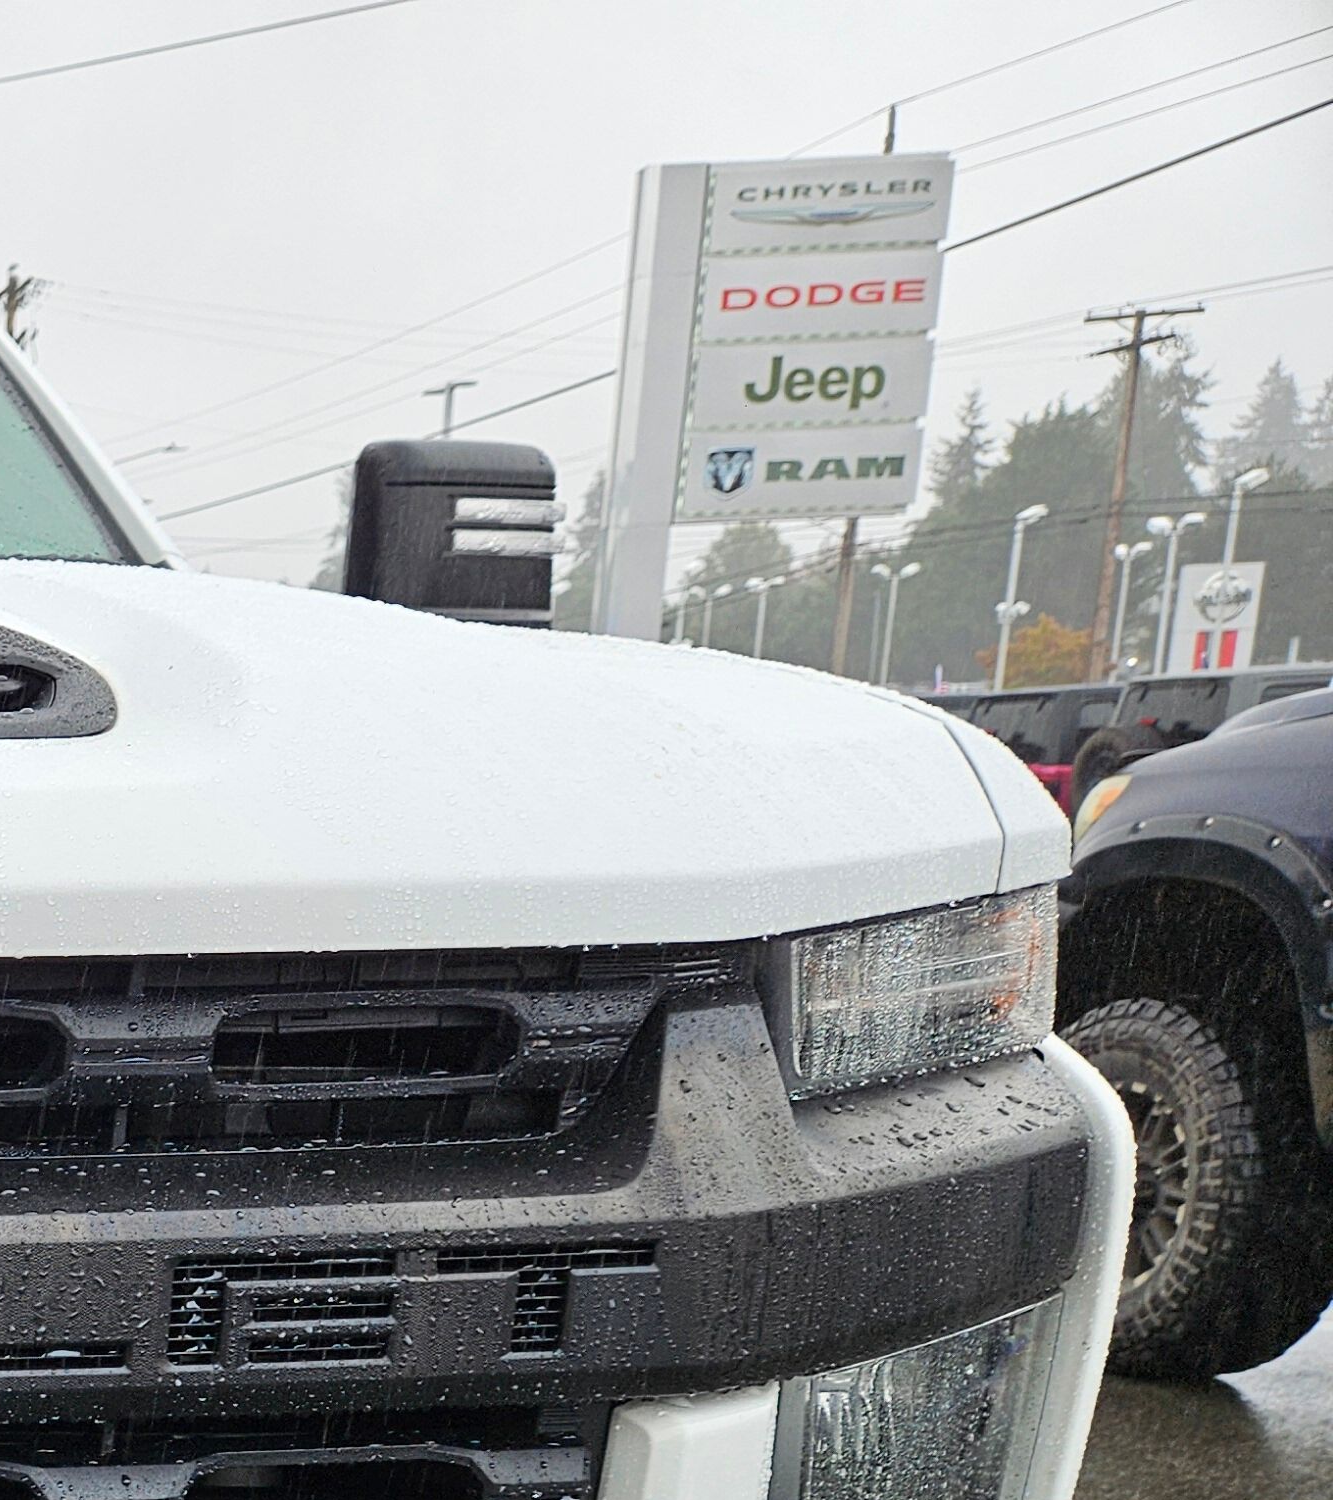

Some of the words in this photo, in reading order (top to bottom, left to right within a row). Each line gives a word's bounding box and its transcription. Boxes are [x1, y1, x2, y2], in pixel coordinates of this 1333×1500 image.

[737, 178, 933, 202] CHRYSLER
[720, 279, 927, 312] DODGE
[744, 355, 886, 410] Jeep
[764, 456, 906, 483] RAM
